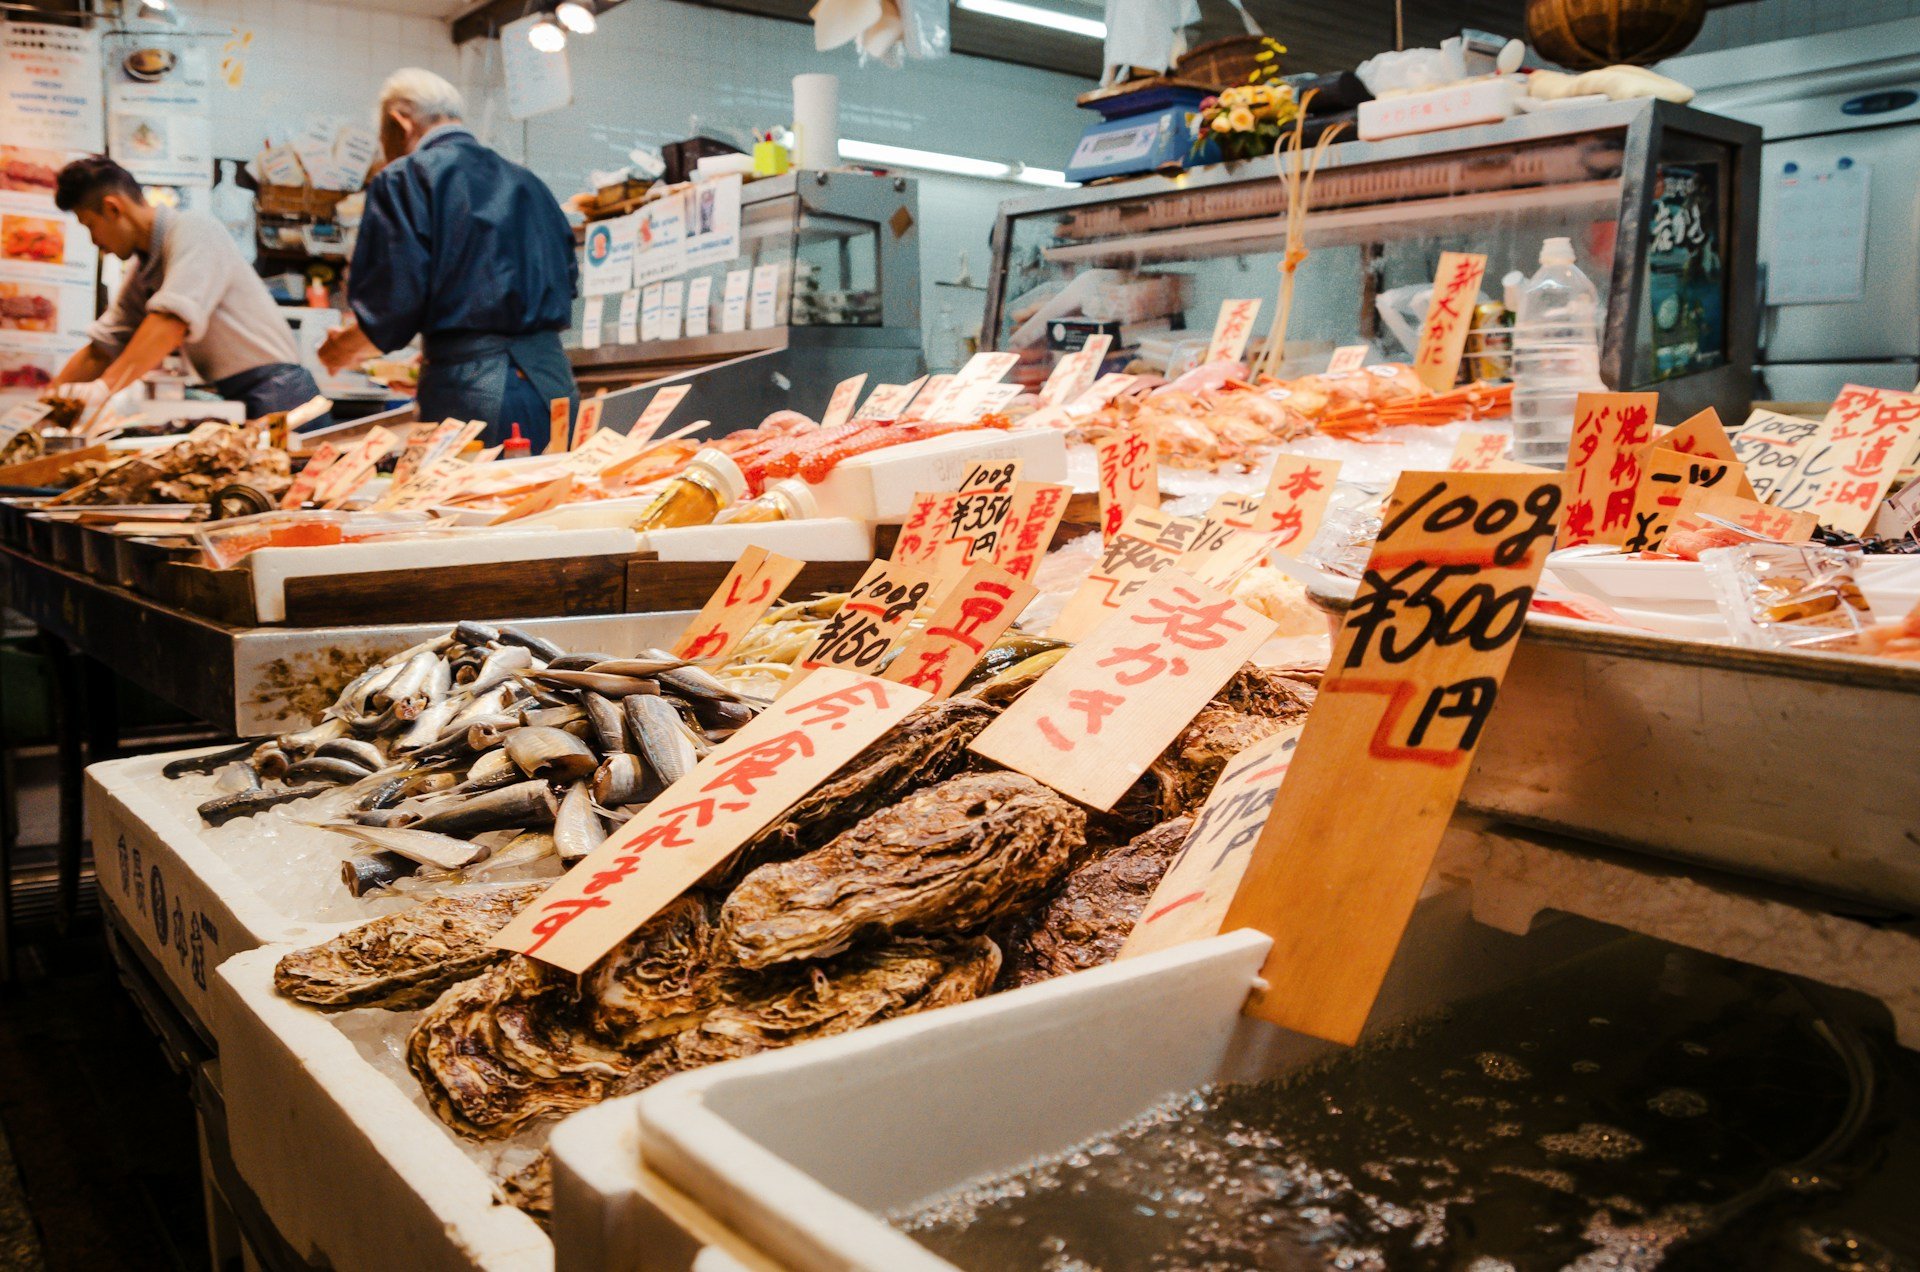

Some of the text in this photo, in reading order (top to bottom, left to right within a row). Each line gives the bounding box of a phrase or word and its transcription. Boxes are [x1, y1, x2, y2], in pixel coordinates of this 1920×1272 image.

[1743, 416, 1819, 444] 100g
[959, 463, 1015, 493] 100g
[1121, 433, 1150, 491] あじ
[951, 495, 1013, 541] ¥350
[970, 532, 997, 557] 円
[1376, 481, 1562, 566] 100g
[851, 571, 930, 623] 100g
[1345, 561, 1535, 669] ¥500
[808, 609, 892, 668] ¥150
[1035, 586, 1248, 752] 活かき
[1407, 676, 1499, 751] 円
